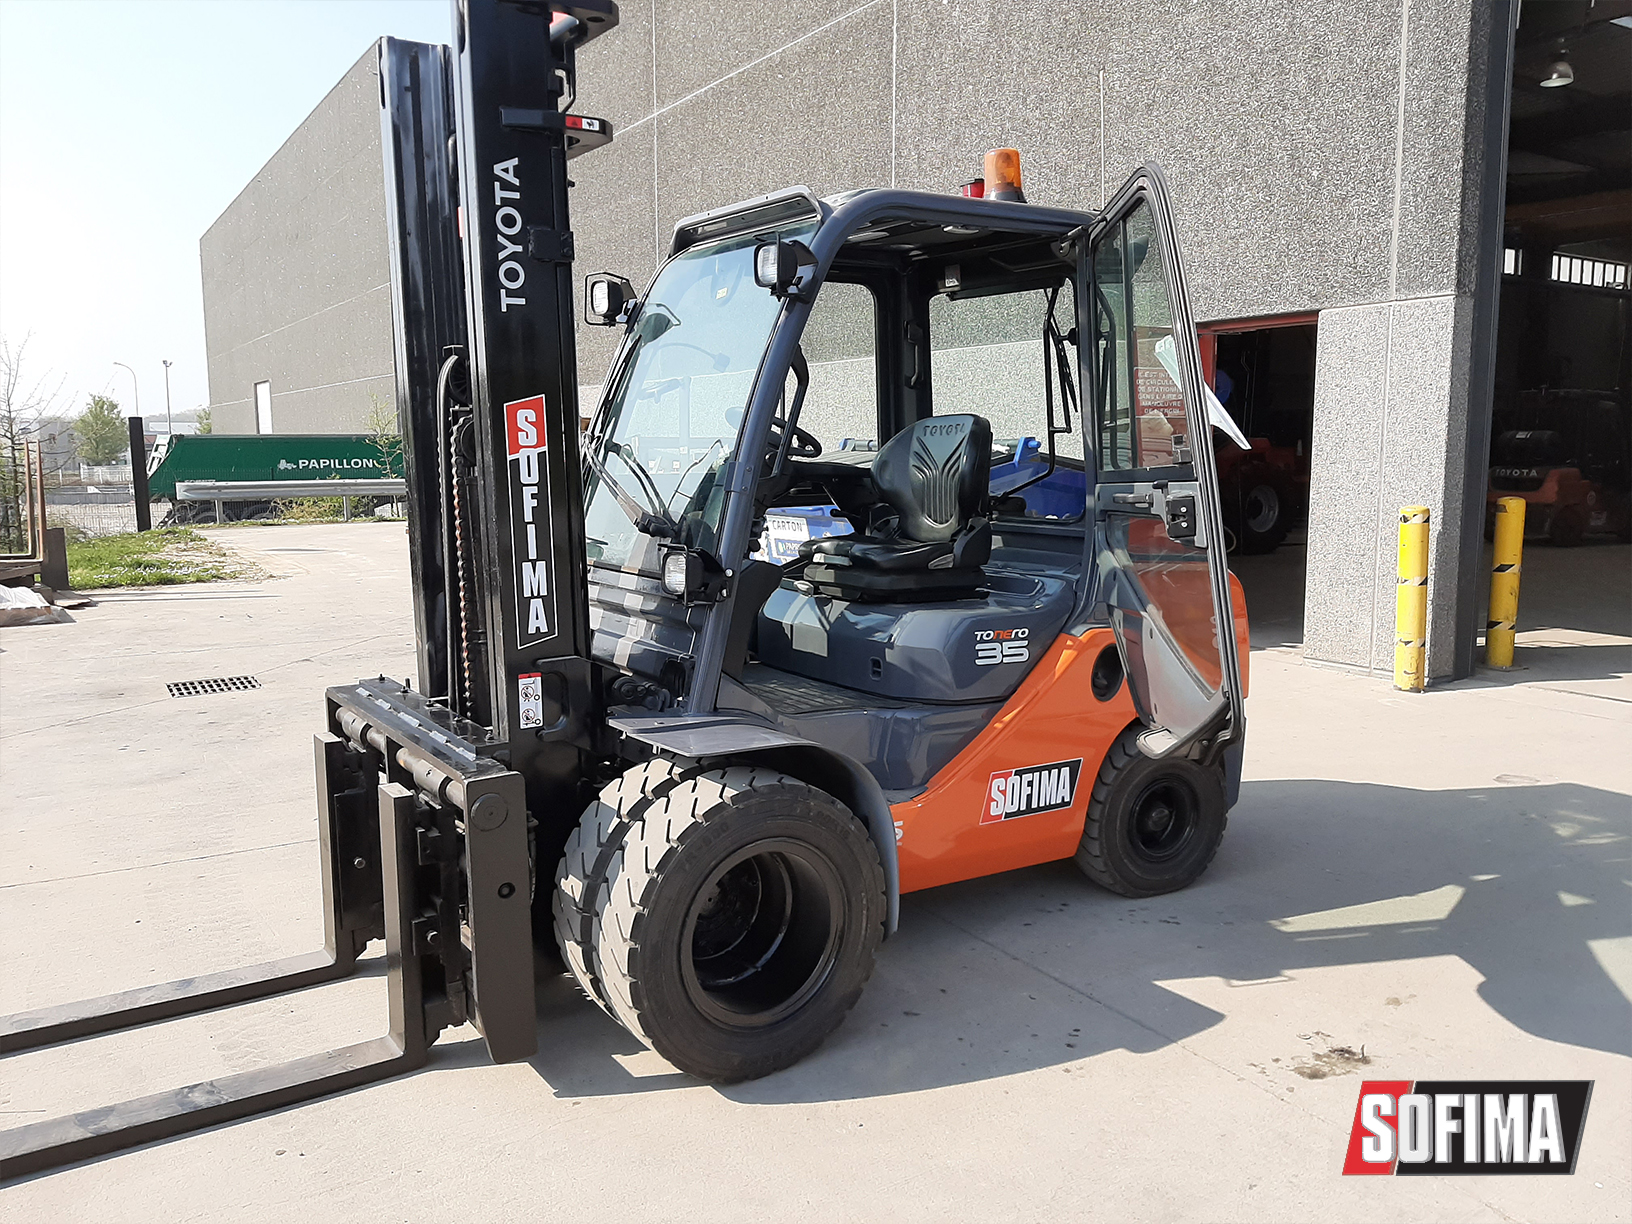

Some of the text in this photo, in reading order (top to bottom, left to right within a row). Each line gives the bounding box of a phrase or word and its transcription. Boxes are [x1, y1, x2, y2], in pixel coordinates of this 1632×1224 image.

[493, 157, 526, 312] TOYOTA
[923, 422, 966, 437] TOYOTA
[298, 458, 373, 470] PAPILLON
[1496, 468, 1538, 477] TOYOTA
[516, 408, 549, 635] SOFIMA
[771, 519, 803, 532] CARTON
[975, 640, 1029, 666] 35
[990, 766, 1071, 817] SOFIMA
